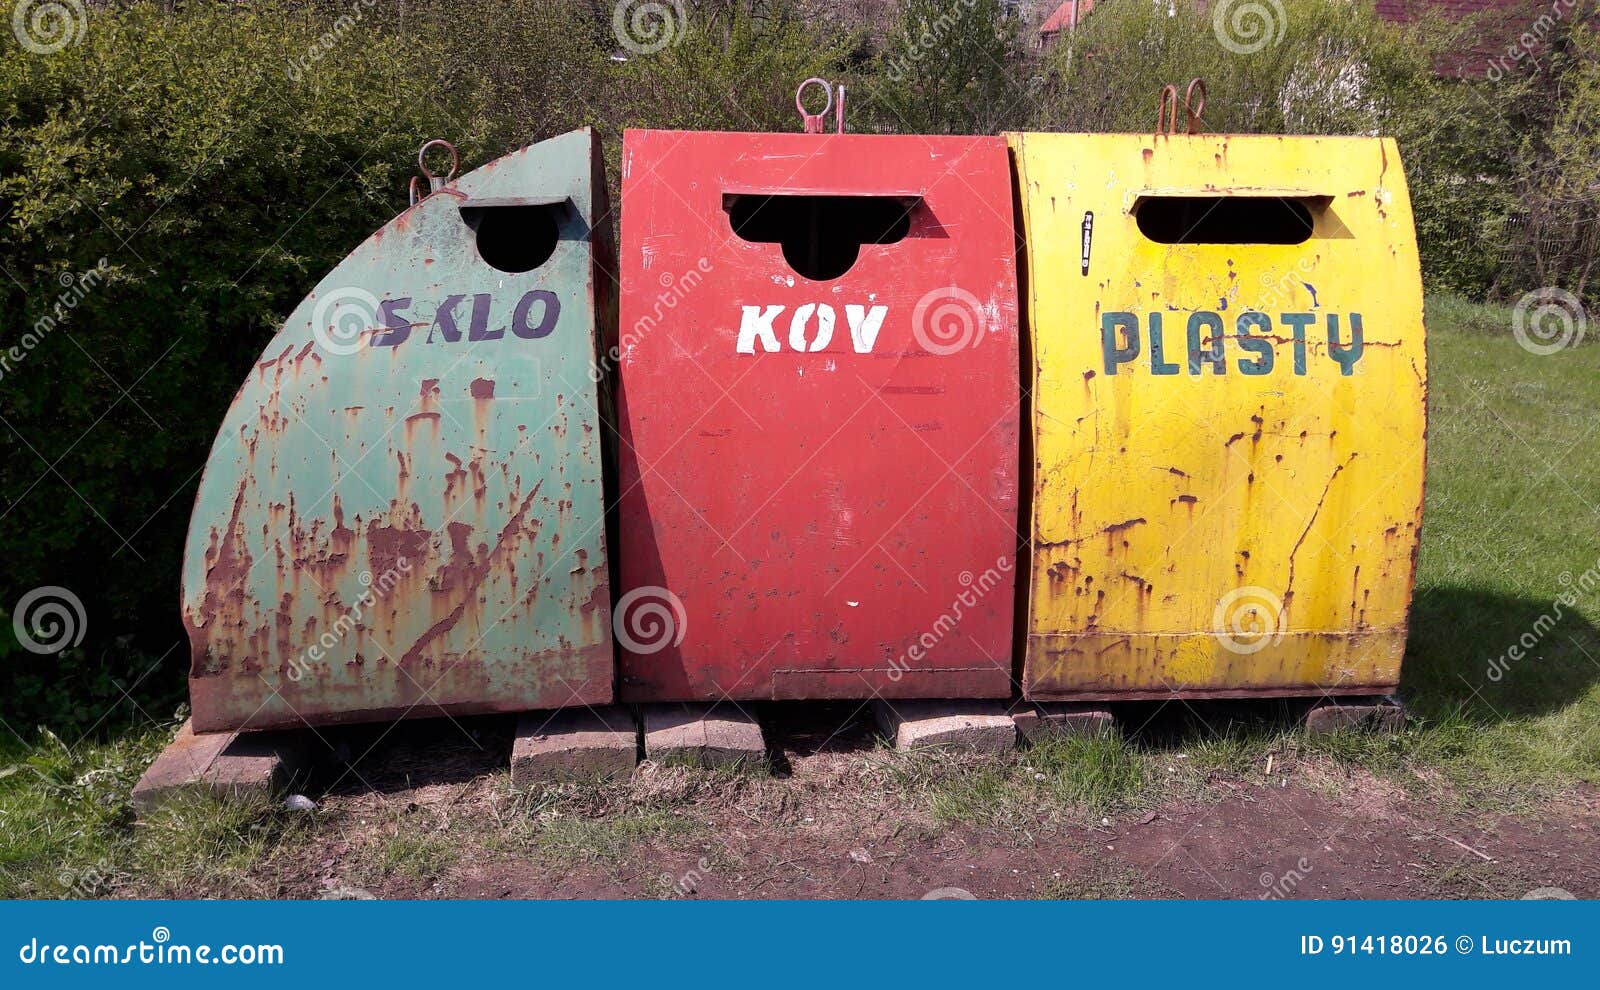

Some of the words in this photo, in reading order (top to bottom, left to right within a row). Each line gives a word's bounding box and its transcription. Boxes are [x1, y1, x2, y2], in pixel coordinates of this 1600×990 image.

[369, 290, 561, 347] SKLO
[736, 303, 888, 355] KOV
[1101, 312, 1364, 376] PLASTY
